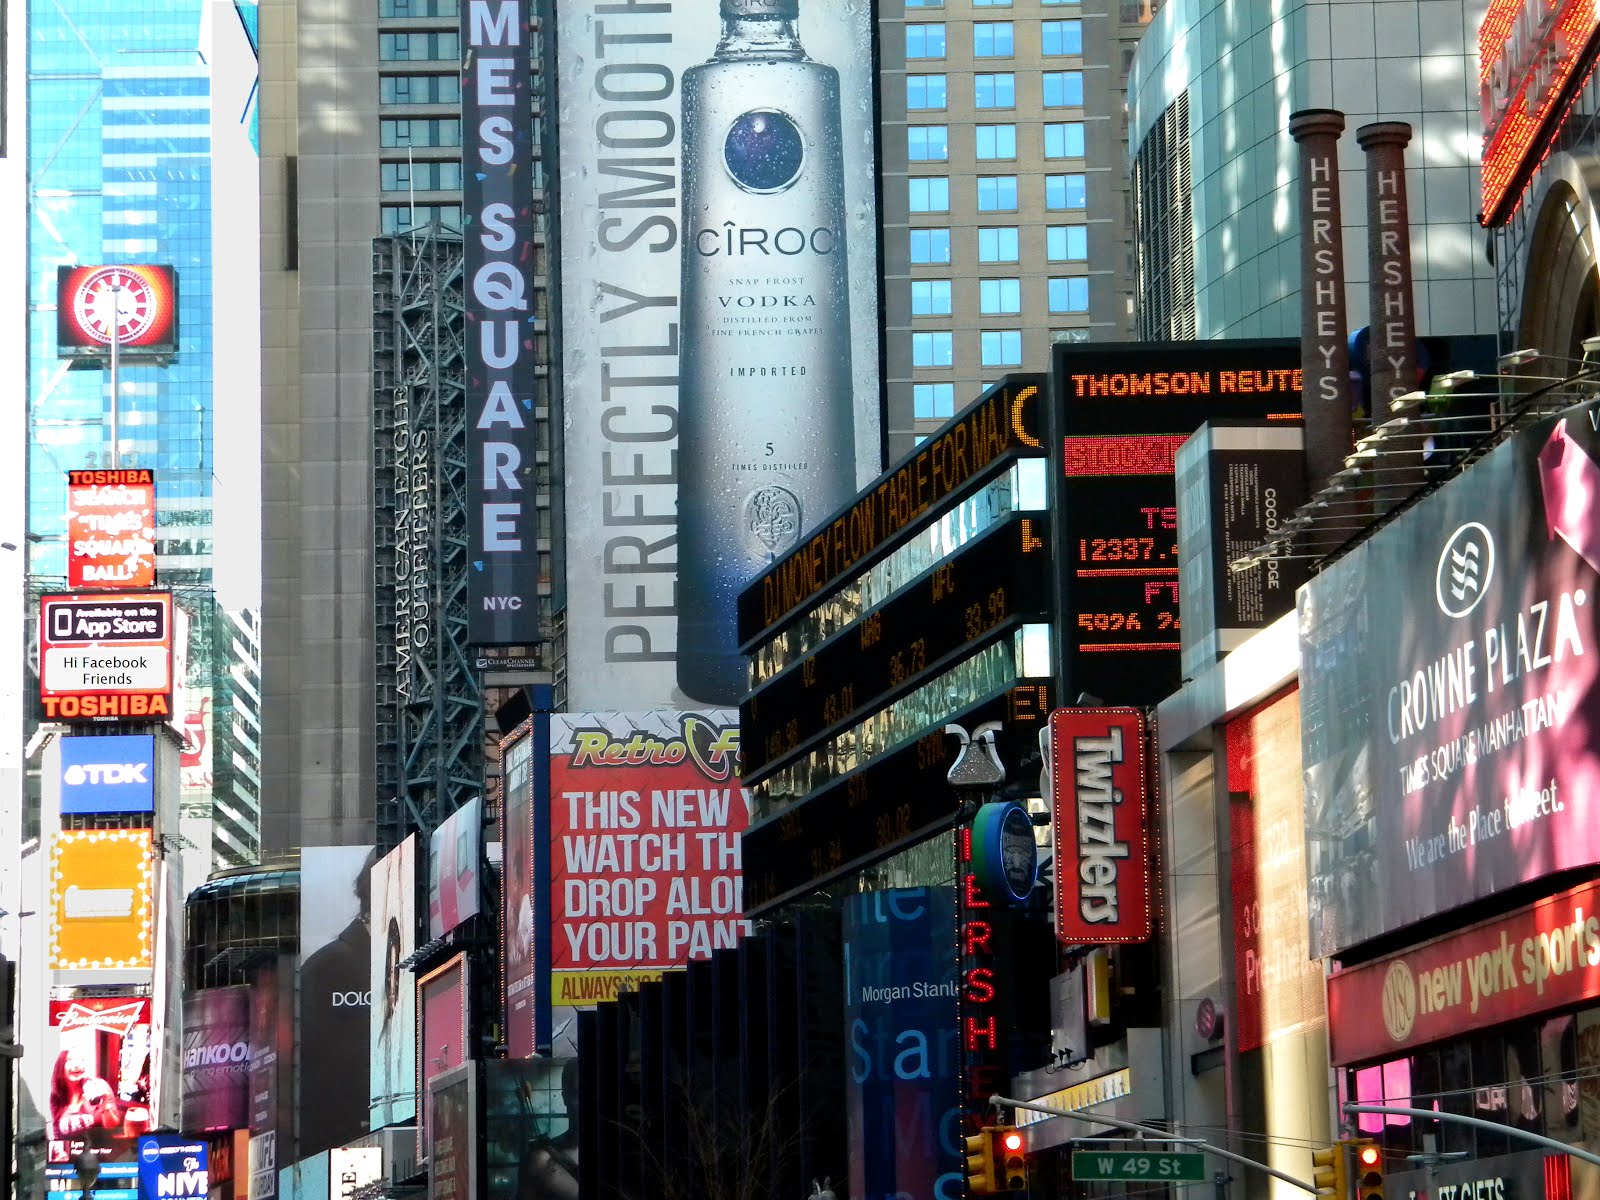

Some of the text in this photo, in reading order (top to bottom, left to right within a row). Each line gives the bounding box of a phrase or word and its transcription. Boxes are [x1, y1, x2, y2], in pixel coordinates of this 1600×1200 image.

[728, 277, 805, 286] SNAP FROST
[718, 294, 817, 308] VODKA
[723, 315, 813, 324] DISTILLED FROM
[473, 203, 527, 552] SQUARE
[730, 366, 807, 377] IMPORTED
[1072, 372, 1211, 397] THOMSON
[765, 442, 775, 456] 5
[70, 470, 151, 484] TOSHIBA
[599, 281, 679, 663] PERFECTLY
[731, 462, 809, 471] TIMES DISTILLED
[782, 526, 832, 612] MONEY
[834, 494, 876, 577] FLOW
[878, 453, 929, 542] TABLE
[931, 421, 970, 501] FOR
[394, 385, 411, 698] AMERICAN EAGLE
[412, 429, 430, 648] OUTFITTERS
[76, 607, 157, 618] Available on the
[483, 596, 522, 611] NYC
[76, 617, 157, 638] App Store
[63, 656, 147, 668] Hi Facebook
[1387, 591, 1584, 745] CROWNE PLAZA
[83, 672, 132, 685] Friends
[41, 694, 169, 717] TOSHIBA
[572, 731, 687, 767] Retro
[708, 728, 741, 764] F
[1399, 688, 1571, 797] TIMES SQUARE MANHATTAN
[82, 763, 148, 784] TDK
[562, 790, 641, 830] THIS
[651, 788, 731, 828] NEW
[1076, 726, 1130, 923] Twizzlers
[1405, 837, 1425, 872] We
[1426, 833, 1446, 863] are
[1447, 815, 1468, 855] the
[1468, 804, 1501, 846] Place
[563, 833, 686, 874] WATCH
[564, 876, 657, 917] DROP
[562, 921, 657, 962] YOUR
[1419, 960, 1463, 1015] new
[1466, 930, 1518, 1014] york
[1521, 907, 1600, 995] sports
[561, 975, 621, 1000] ALWAYS
[862, 985, 911, 1004] Morgan
[1098, 1157, 1181, 1175] W 49 St
